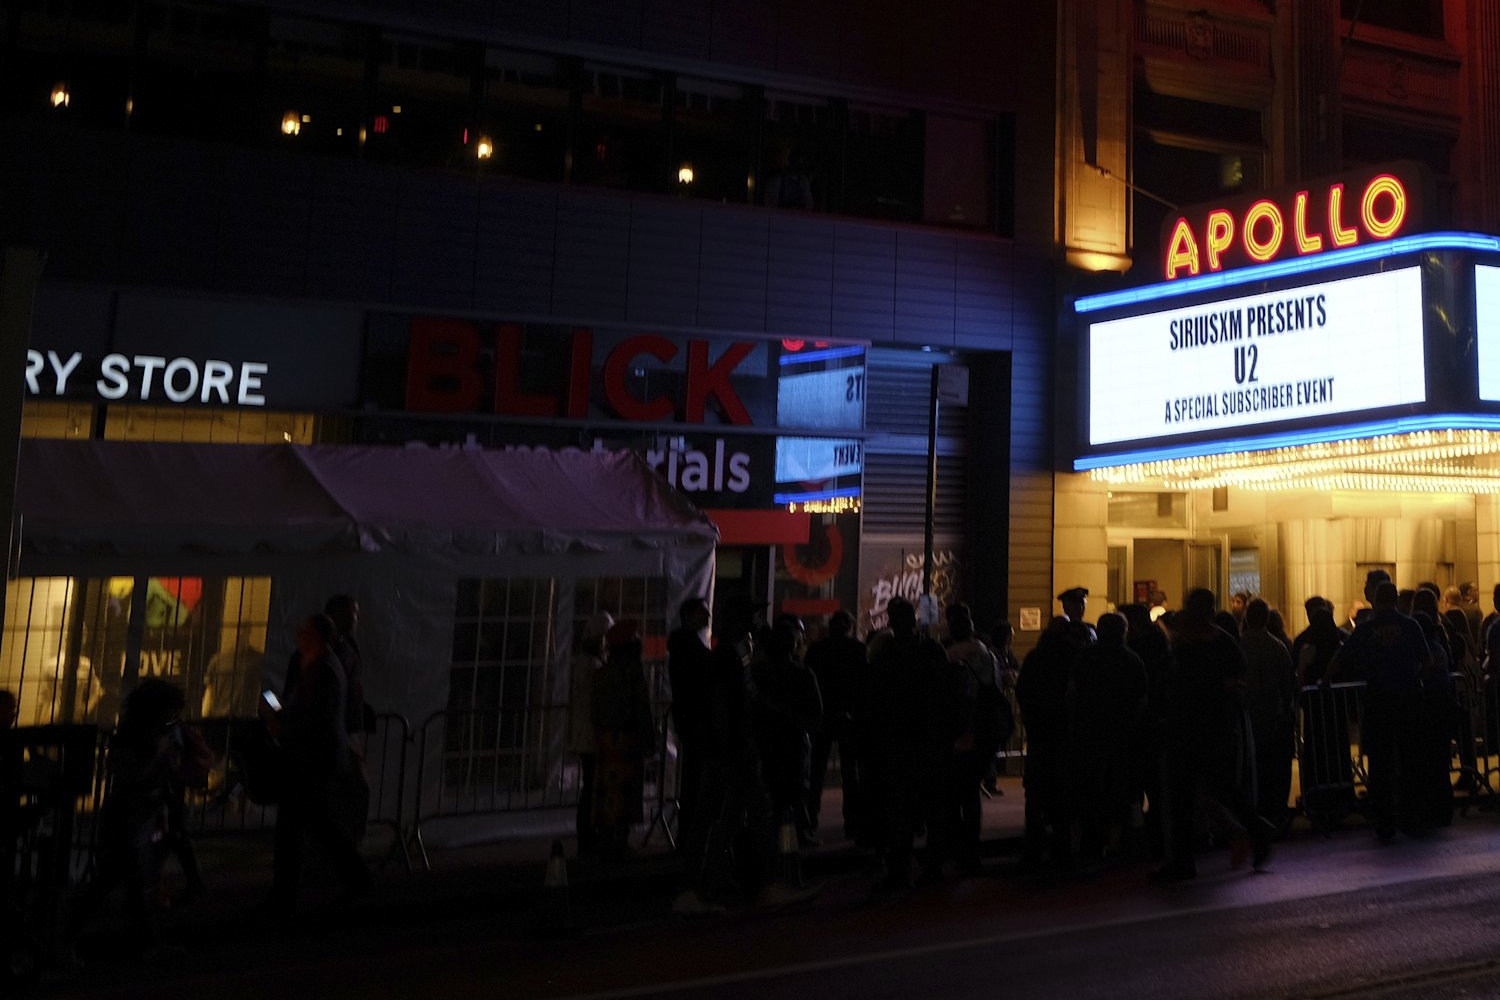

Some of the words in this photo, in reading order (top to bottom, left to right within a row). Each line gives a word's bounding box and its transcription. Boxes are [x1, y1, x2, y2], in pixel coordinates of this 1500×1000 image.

[1166, 173, 1406, 280] APOLLO
[1169, 307, 1243, 350] SIRIUSXM
[1247, 294, 1327, 338] PRESENTS
[96, 352, 269, 406] STORE
[405, 316, 756, 426] BLICK
[1233, 344, 1259, 384] U2
[1164, 400, 1172, 424] A
[1174, 391, 1219, 422] SPECIAL
[1222, 384, 1293, 415] SUBSCRIBER
[1297, 377, 1335, 407] EVENT
